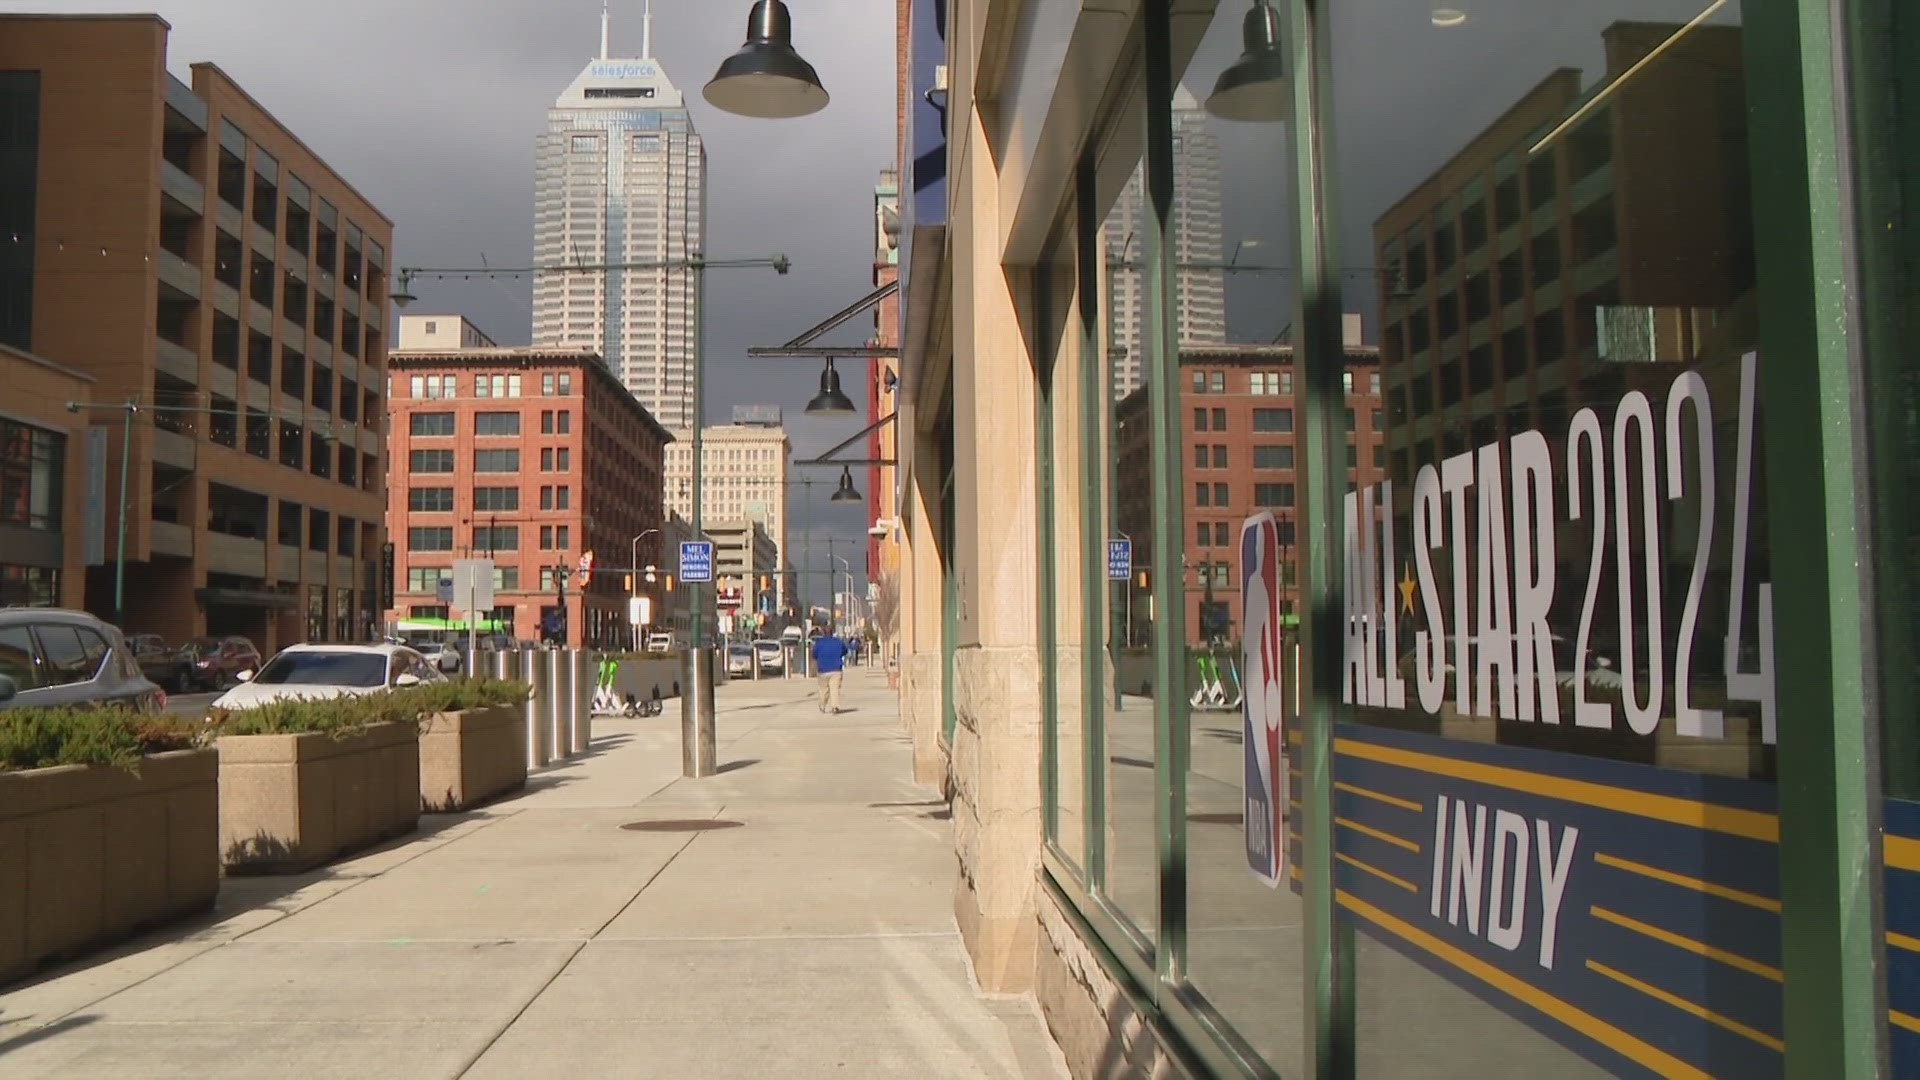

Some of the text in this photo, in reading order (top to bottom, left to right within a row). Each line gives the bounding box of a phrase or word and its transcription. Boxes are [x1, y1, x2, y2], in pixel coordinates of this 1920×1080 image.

[591, 63, 654, 79] salesforce
[682, 553, 709, 561] SIMON
[1343, 350, 1777, 744] ALL STAR 2024
[1248, 796, 1268, 859] NBA
[1430, 794, 1579, 971] INDY
